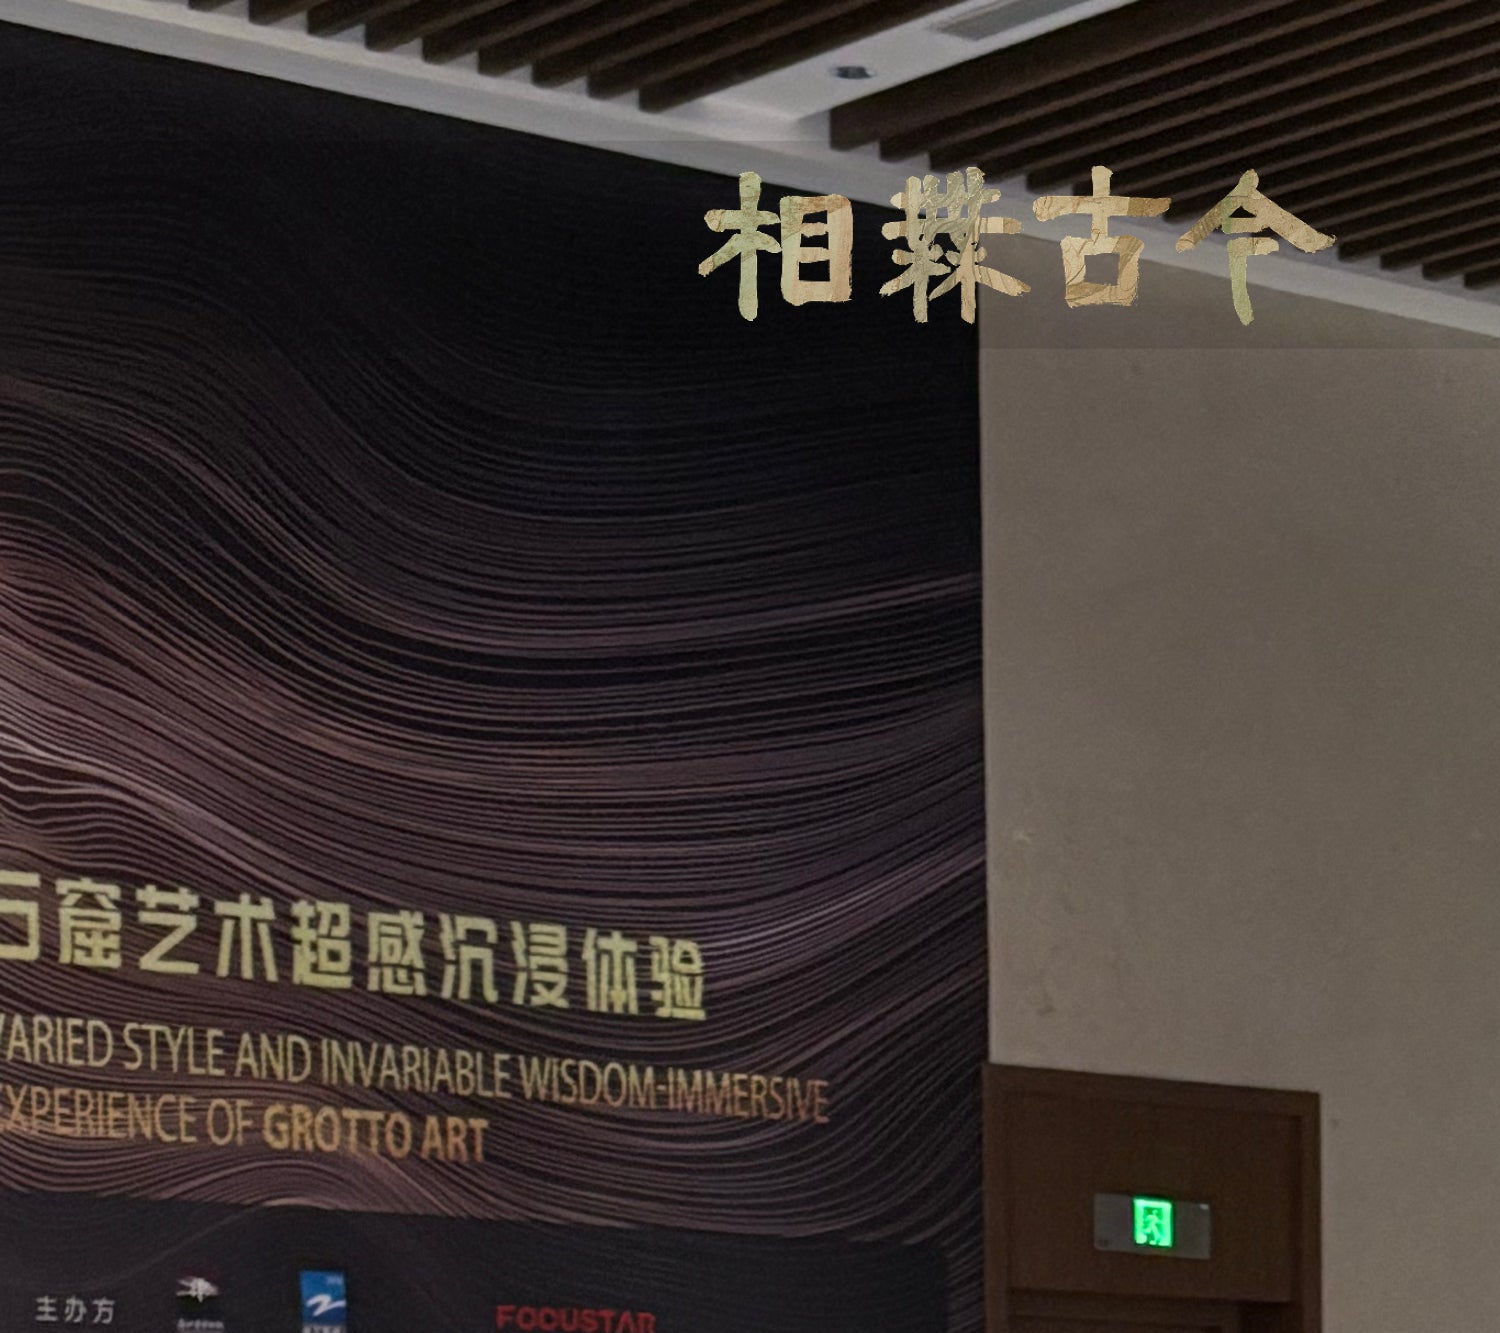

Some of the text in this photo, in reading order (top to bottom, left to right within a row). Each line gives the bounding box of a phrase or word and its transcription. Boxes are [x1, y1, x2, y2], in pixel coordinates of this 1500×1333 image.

[0, 1013, 113, 1067] ARIED
[123, 1022, 225, 1076] STYLE
[234, 1032, 311, 1083] AND
[322, 1038, 512, 1099] INVARIABLE
[0, 1084, 488, 1163] XPERIENCE OF GROTTO ART
[36, 1296, 115, 1325] 主办方
